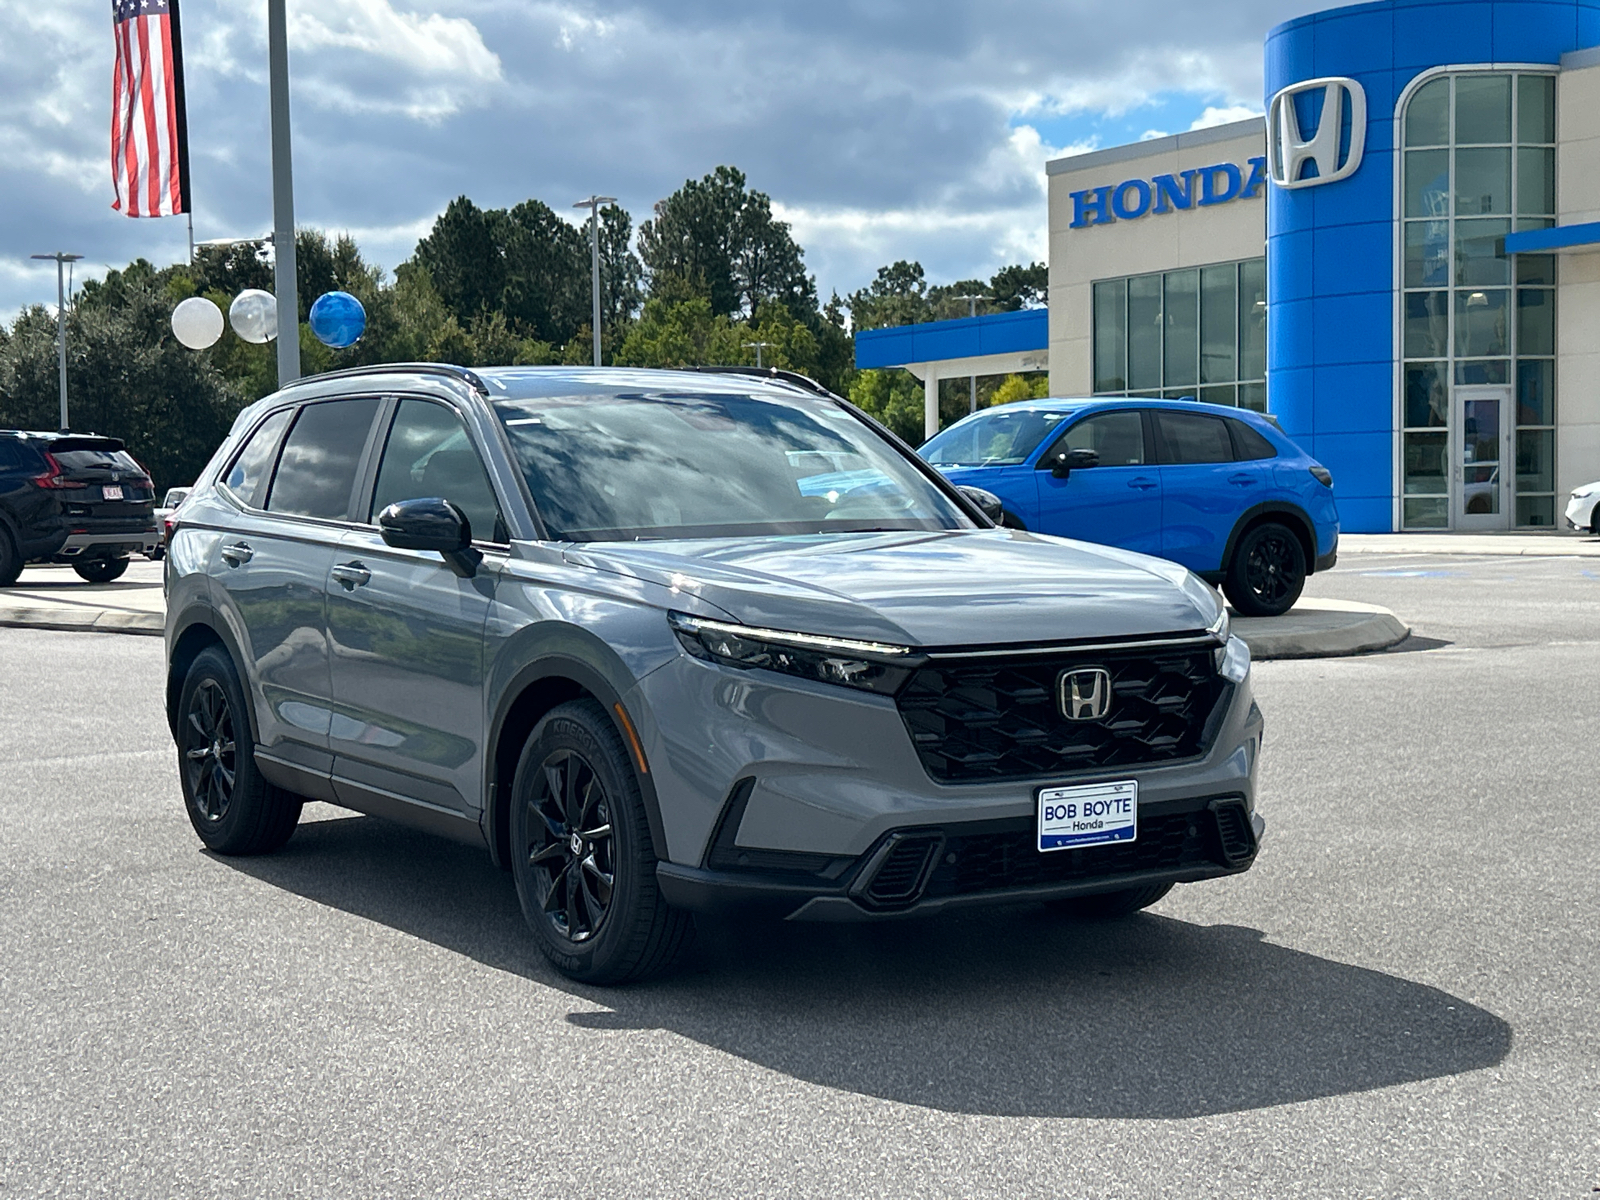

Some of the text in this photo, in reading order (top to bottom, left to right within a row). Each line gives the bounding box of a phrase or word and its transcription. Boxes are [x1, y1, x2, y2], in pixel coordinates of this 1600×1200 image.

[1045, 798, 1132, 821] BOB BOYTE
[1072, 819, 1104, 832] Honda
